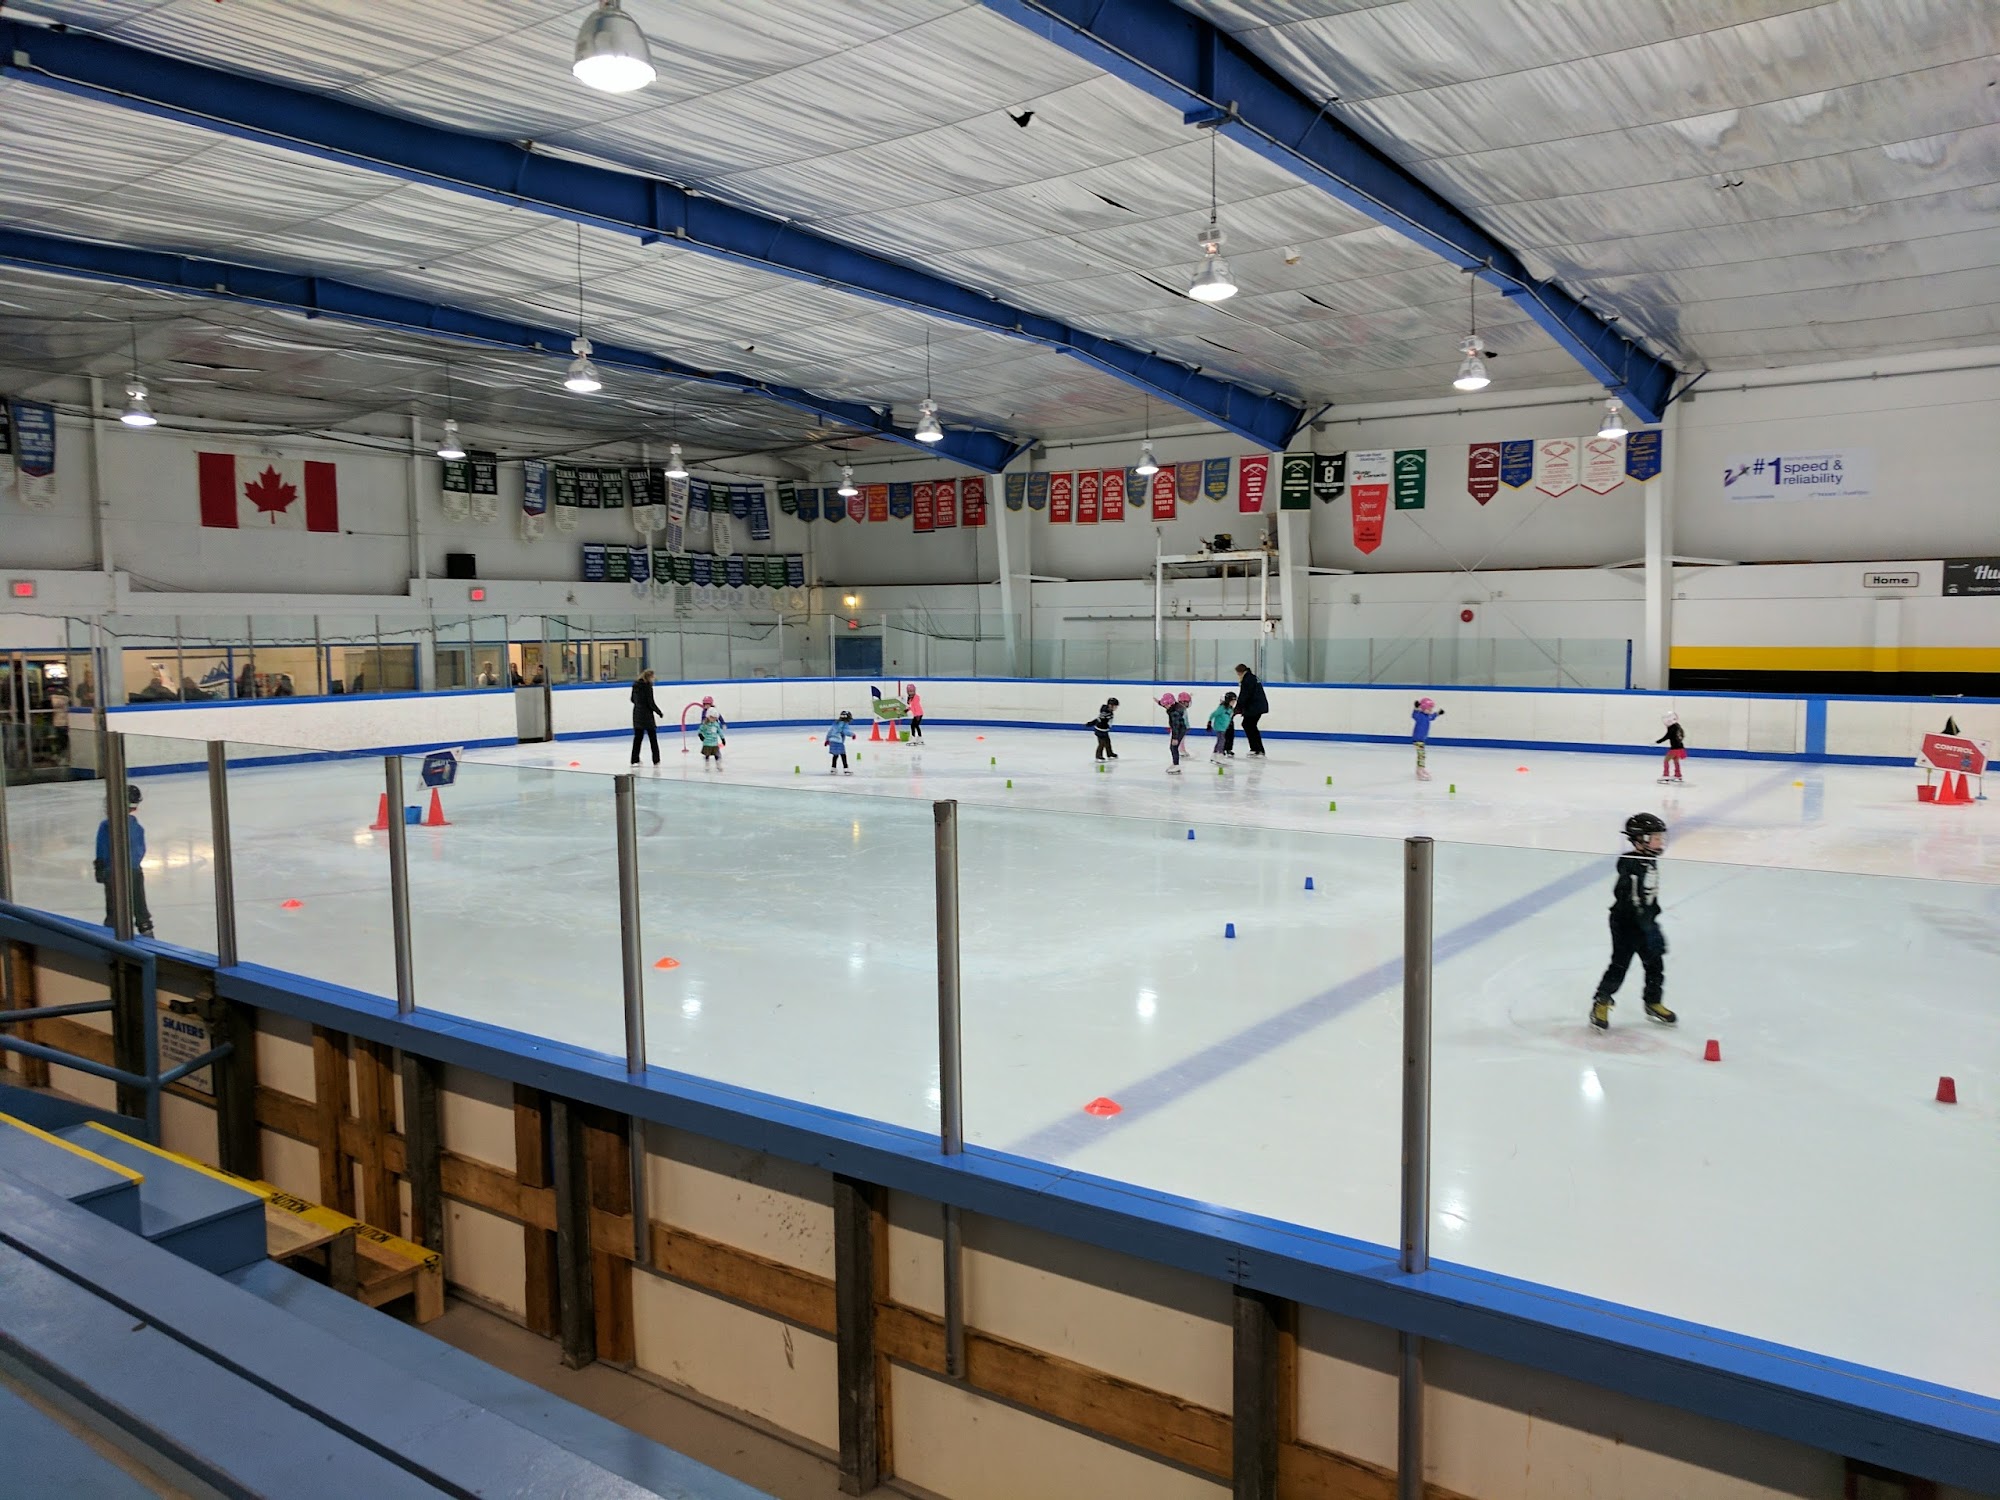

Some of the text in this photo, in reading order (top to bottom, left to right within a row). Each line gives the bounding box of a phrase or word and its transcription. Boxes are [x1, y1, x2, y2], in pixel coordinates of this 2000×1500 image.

[1324, 466, 1335, 482] 8
[1753, 457, 1781, 485] #1
[1784, 460, 1843, 475] speed &
[1784, 474, 1843, 485] reliability
[1873, 576, 1909, 584] Home
[1934, 743, 1975, 755] CONTROL
[163, 1016, 204, 1039] SKATERS
